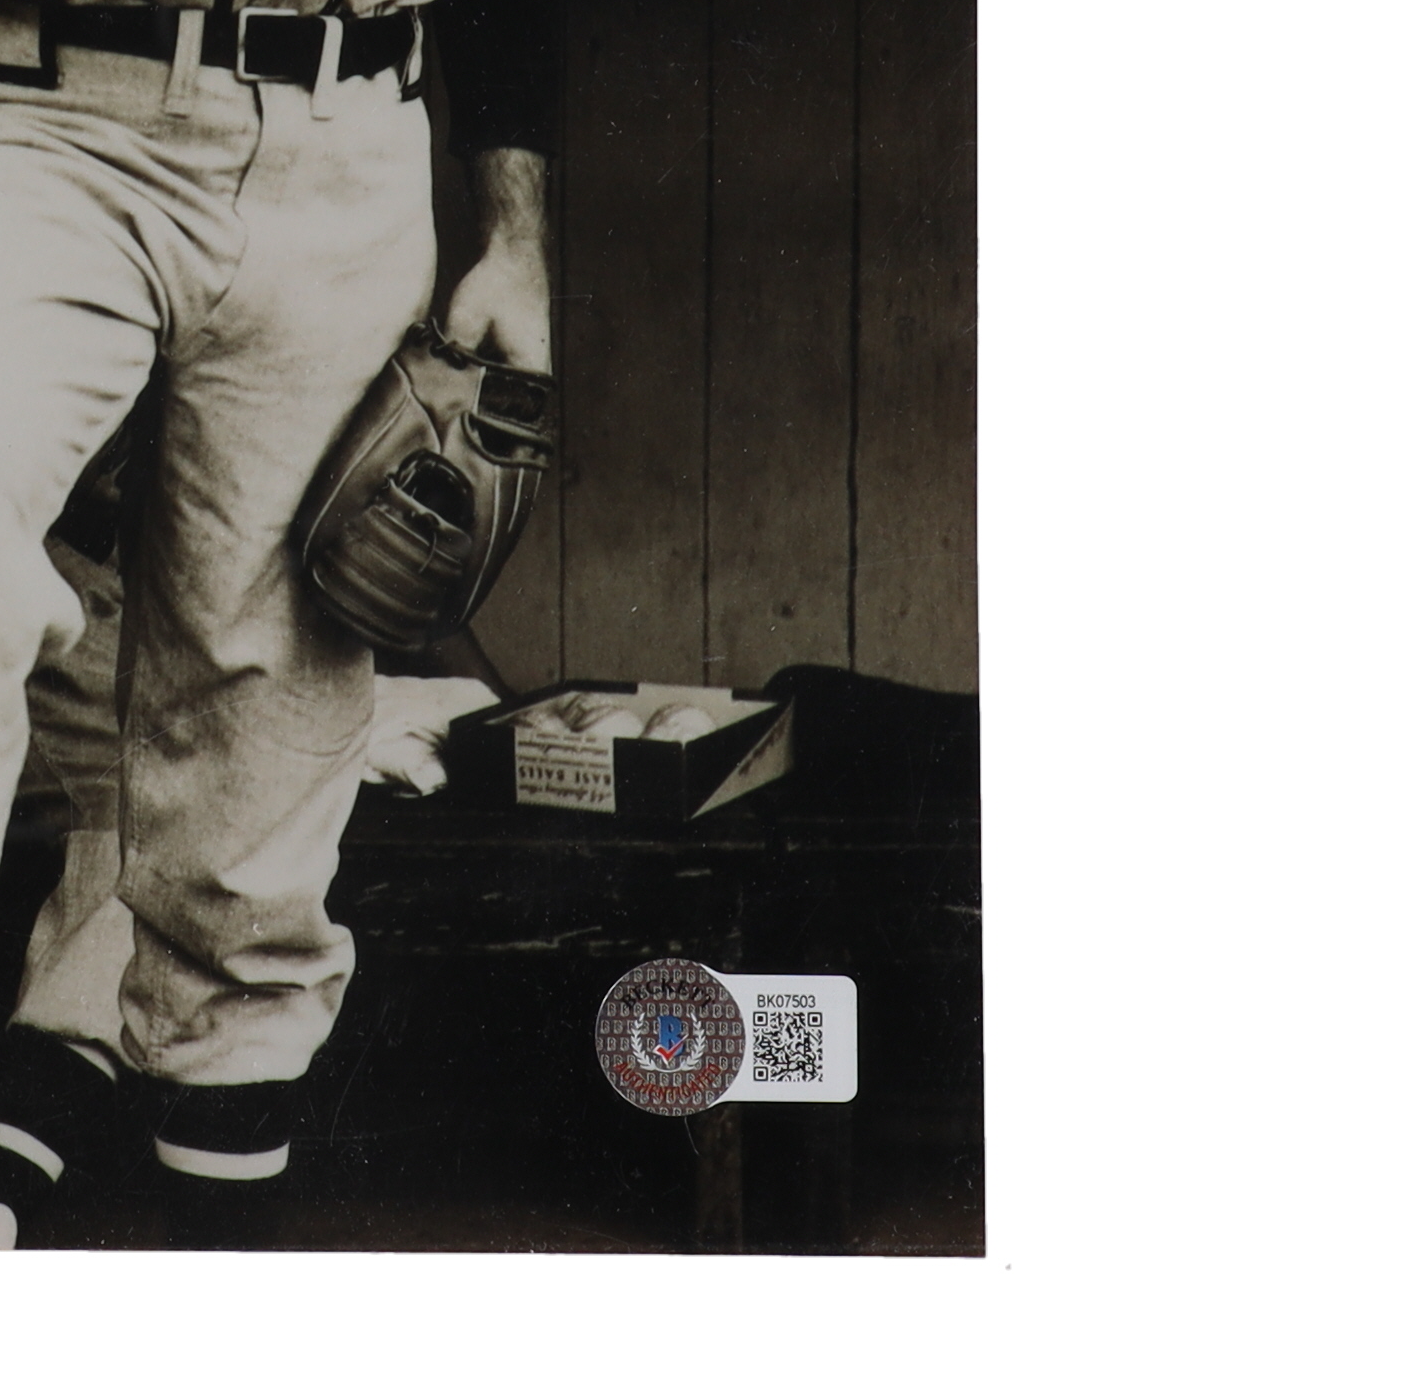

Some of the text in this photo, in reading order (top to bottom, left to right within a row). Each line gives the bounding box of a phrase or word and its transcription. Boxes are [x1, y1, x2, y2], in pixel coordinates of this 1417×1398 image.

[622, 978, 714, 1010] BECKETT
[757, 995, 817, 1008] BK07503
[613, 1061, 723, 1100] AUTHENTICATED
